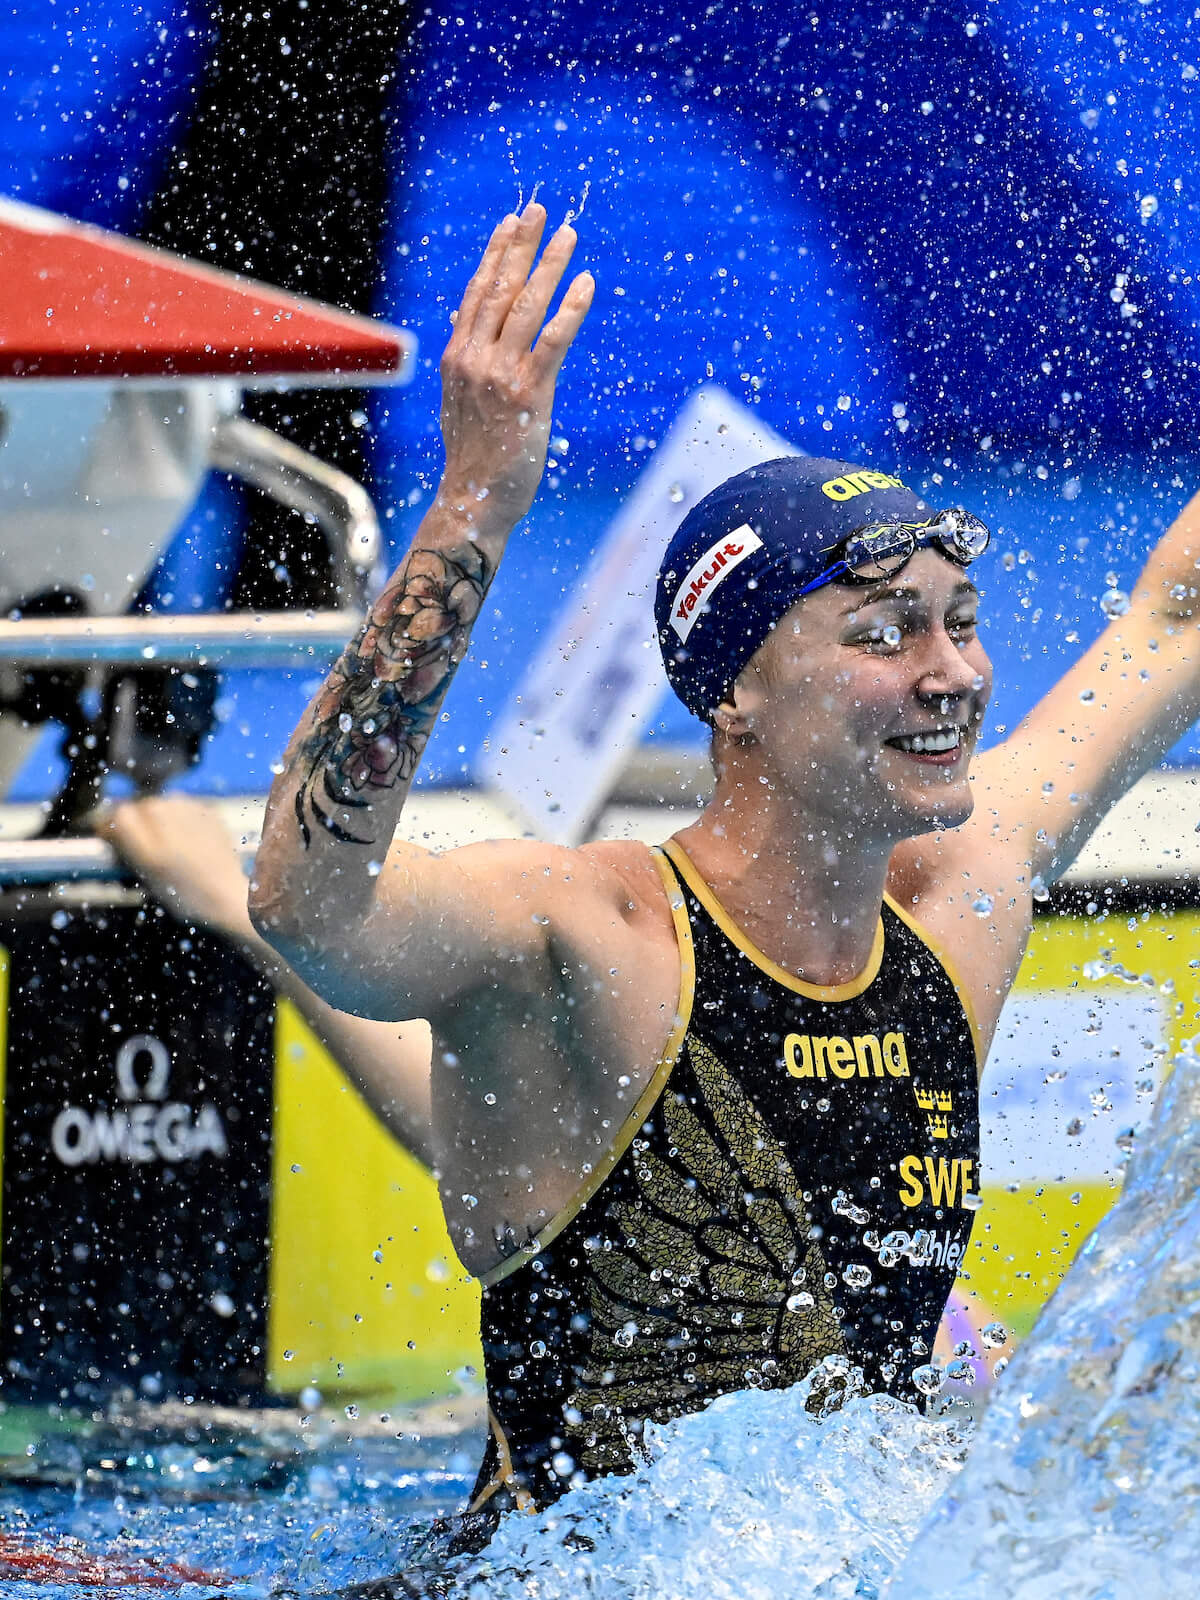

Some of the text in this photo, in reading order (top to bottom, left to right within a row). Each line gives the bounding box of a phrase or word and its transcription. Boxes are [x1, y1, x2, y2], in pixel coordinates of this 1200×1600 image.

[822, 471, 911, 501] aren
[676, 543, 744, 620] Yakult
[784, 1032, 910, 1078] arena
[53, 1104, 227, 1165] OMEGA
[899, 1155, 973, 1209] SWE
